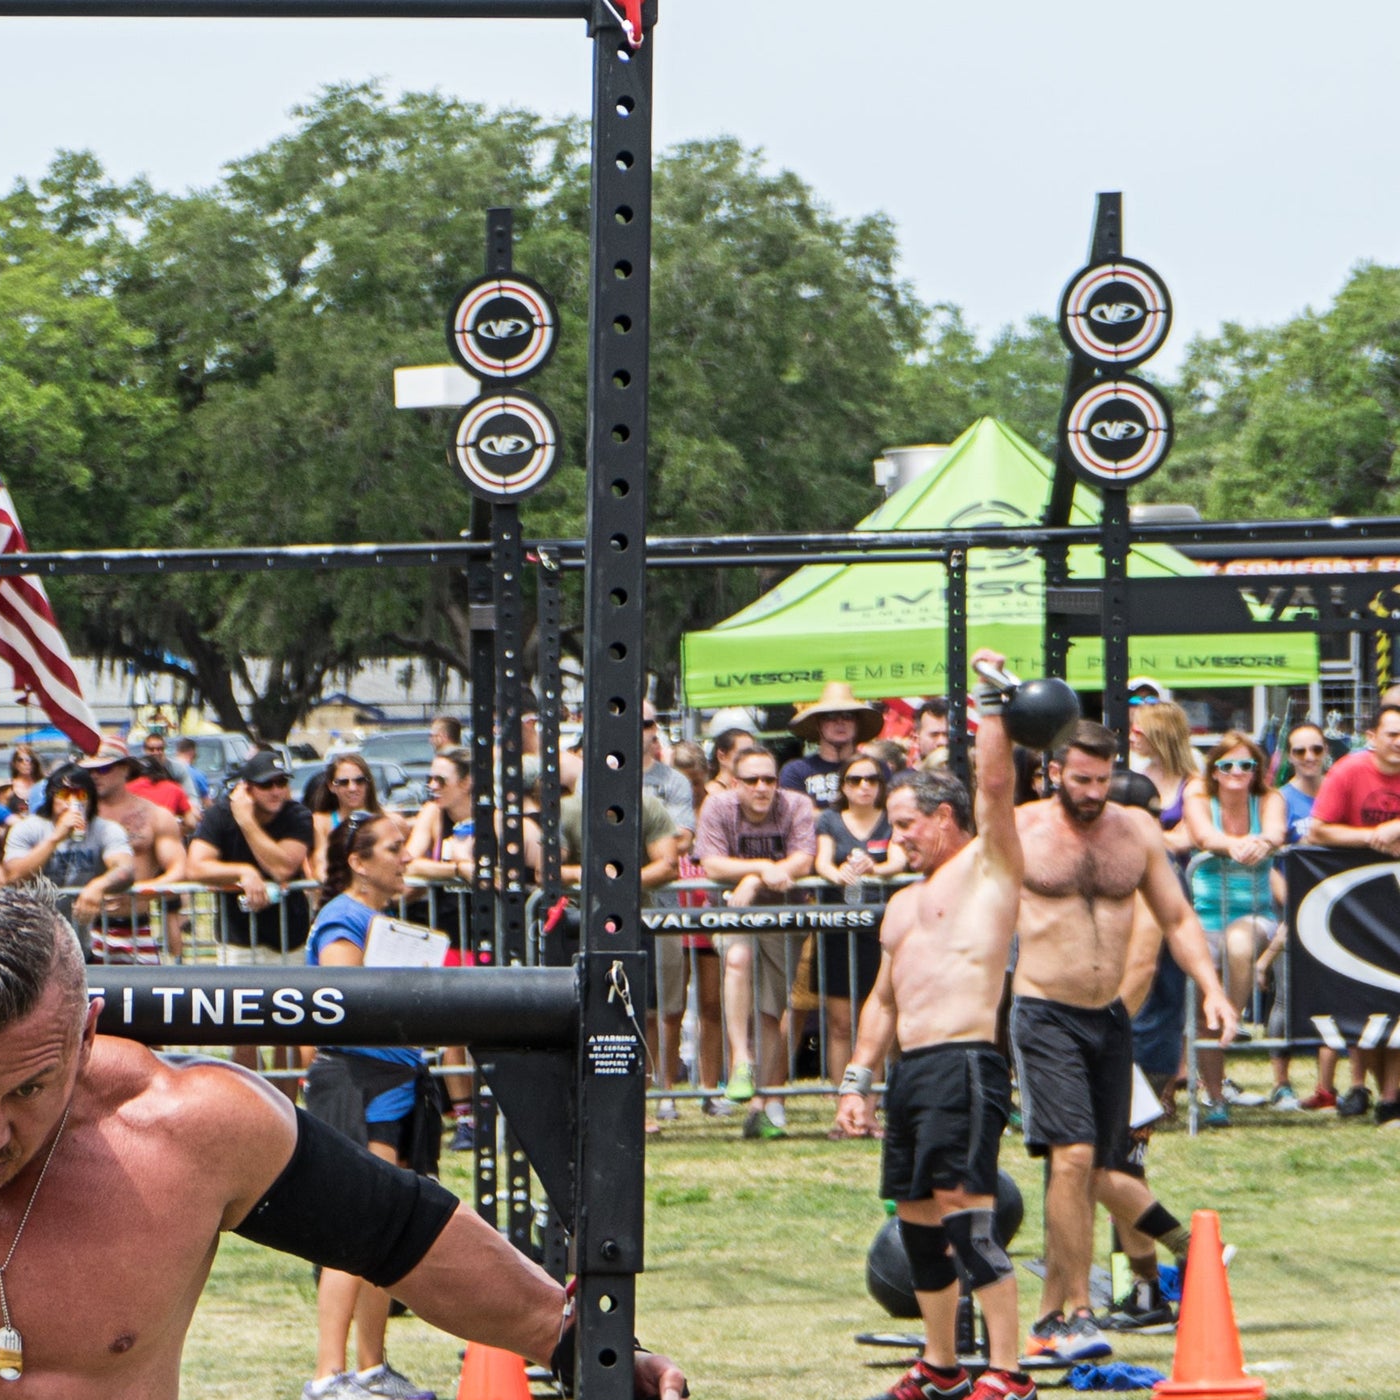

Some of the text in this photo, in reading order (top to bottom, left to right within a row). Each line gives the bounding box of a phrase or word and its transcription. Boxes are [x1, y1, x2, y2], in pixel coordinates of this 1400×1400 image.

[714, 668, 826, 688] LIVESORE
[1087, 655, 1156, 670] PIN
[1175, 655, 1288, 669] LIVESORE
[641, 911, 739, 929] VALOR
[779, 910, 875, 927] FITNESS
